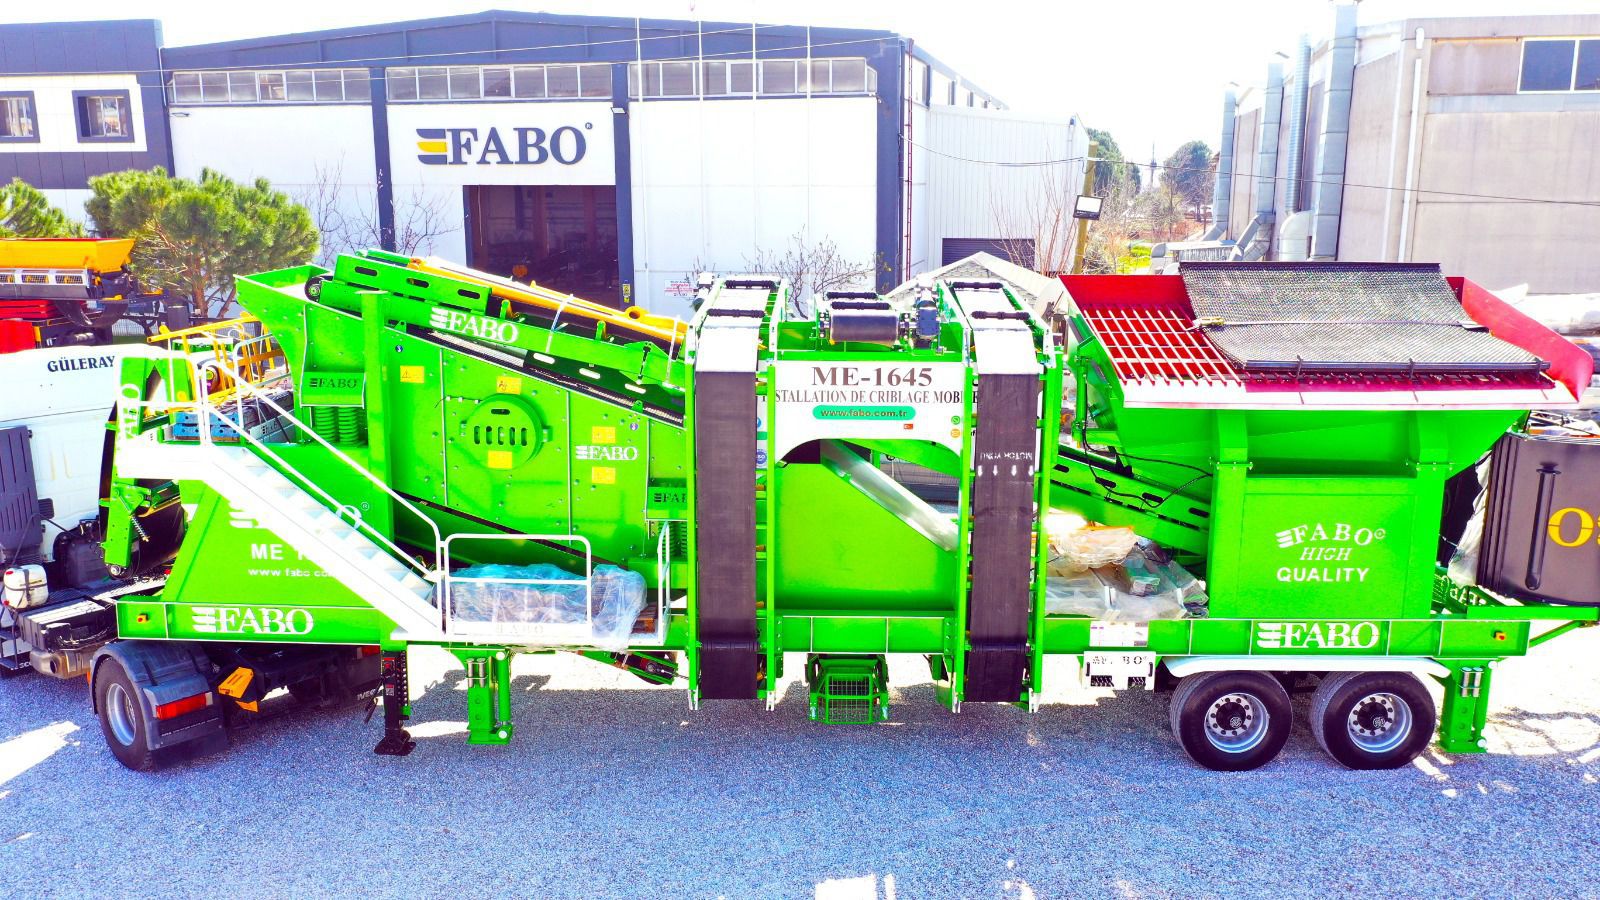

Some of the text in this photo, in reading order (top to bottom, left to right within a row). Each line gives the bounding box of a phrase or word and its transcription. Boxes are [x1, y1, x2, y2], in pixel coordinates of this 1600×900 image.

[446, 126, 587, 166] FABO
[449, 310, 519, 344] FABO
[47, 355, 116, 373] GÜLERAY
[318, 377, 358, 389] FABO
[811, 366, 933, 387] ME-1645
[850, 390, 867, 403] DE
[869, 390, 930, 404] CRIBLAGE
[820, 408, 908, 417] www.fabo.com.tr
[588, 446, 639, 461] FABO
[1294, 522, 1374, 546] FABO
[251, 543, 284, 561] ME
[1299, 547, 1352, 561] HIGH
[1276, 566, 1370, 582] QUALITY
[215, 606, 314, 635] FABO
[1280, 621, 1380, 649] FABO
